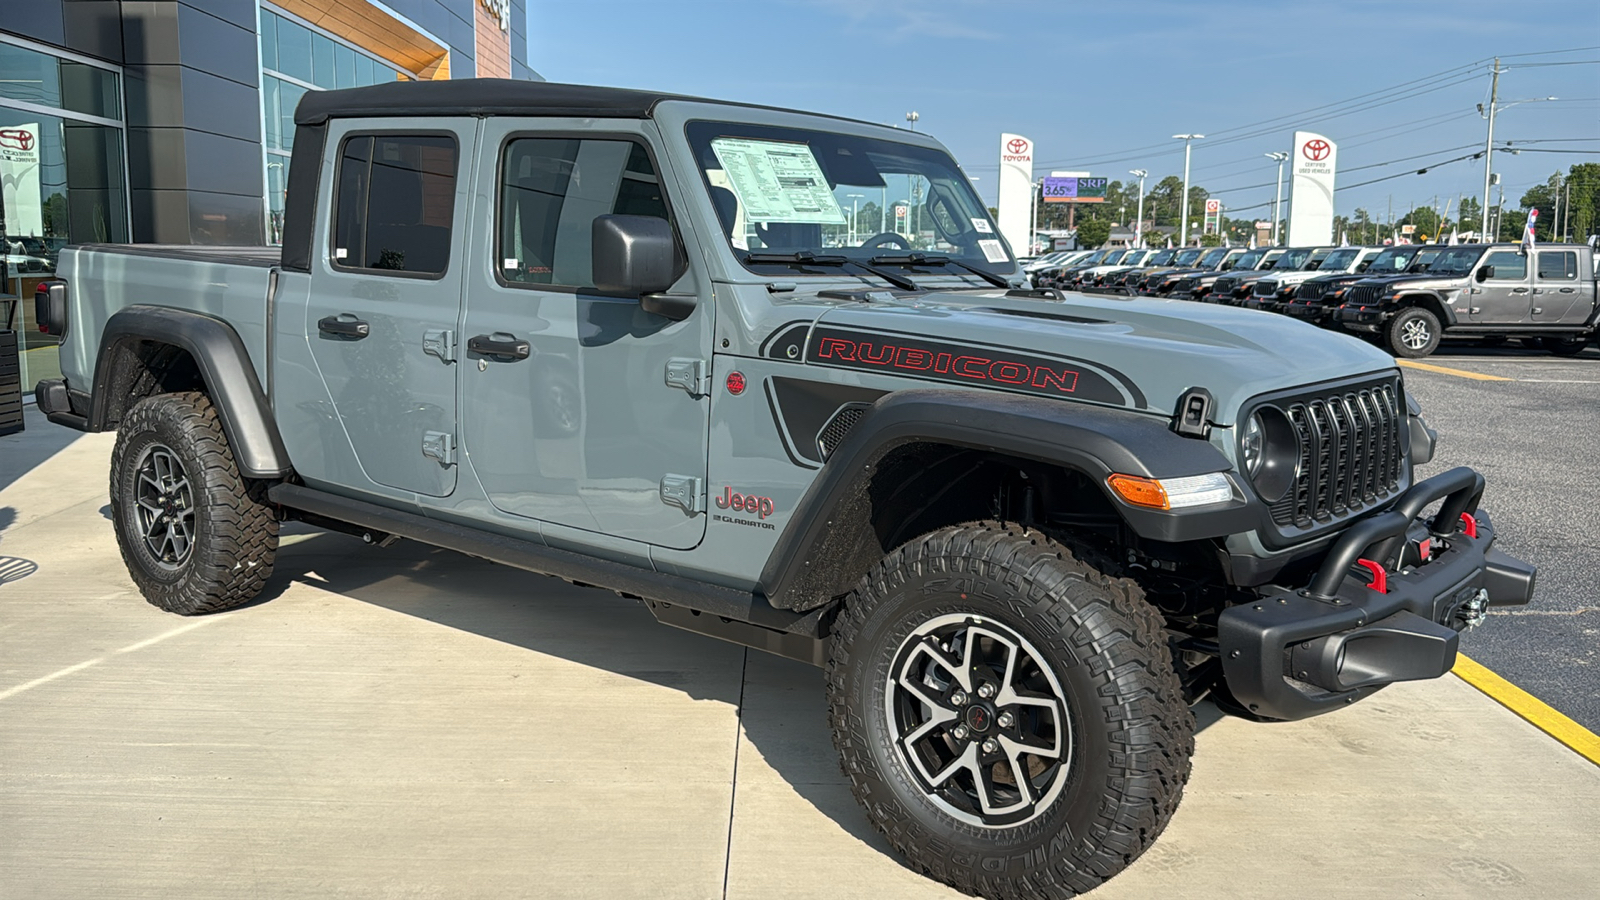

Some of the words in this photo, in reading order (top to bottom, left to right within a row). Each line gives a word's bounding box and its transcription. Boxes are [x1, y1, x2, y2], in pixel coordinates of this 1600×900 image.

[1079, 179, 1106, 188] SRP
[818, 337, 1079, 392] RUBICON
[715, 486, 774, 520] Jeep
[722, 516, 775, 531] GLADIATOR
[882, 797, 1076, 873] WILDPEAK
